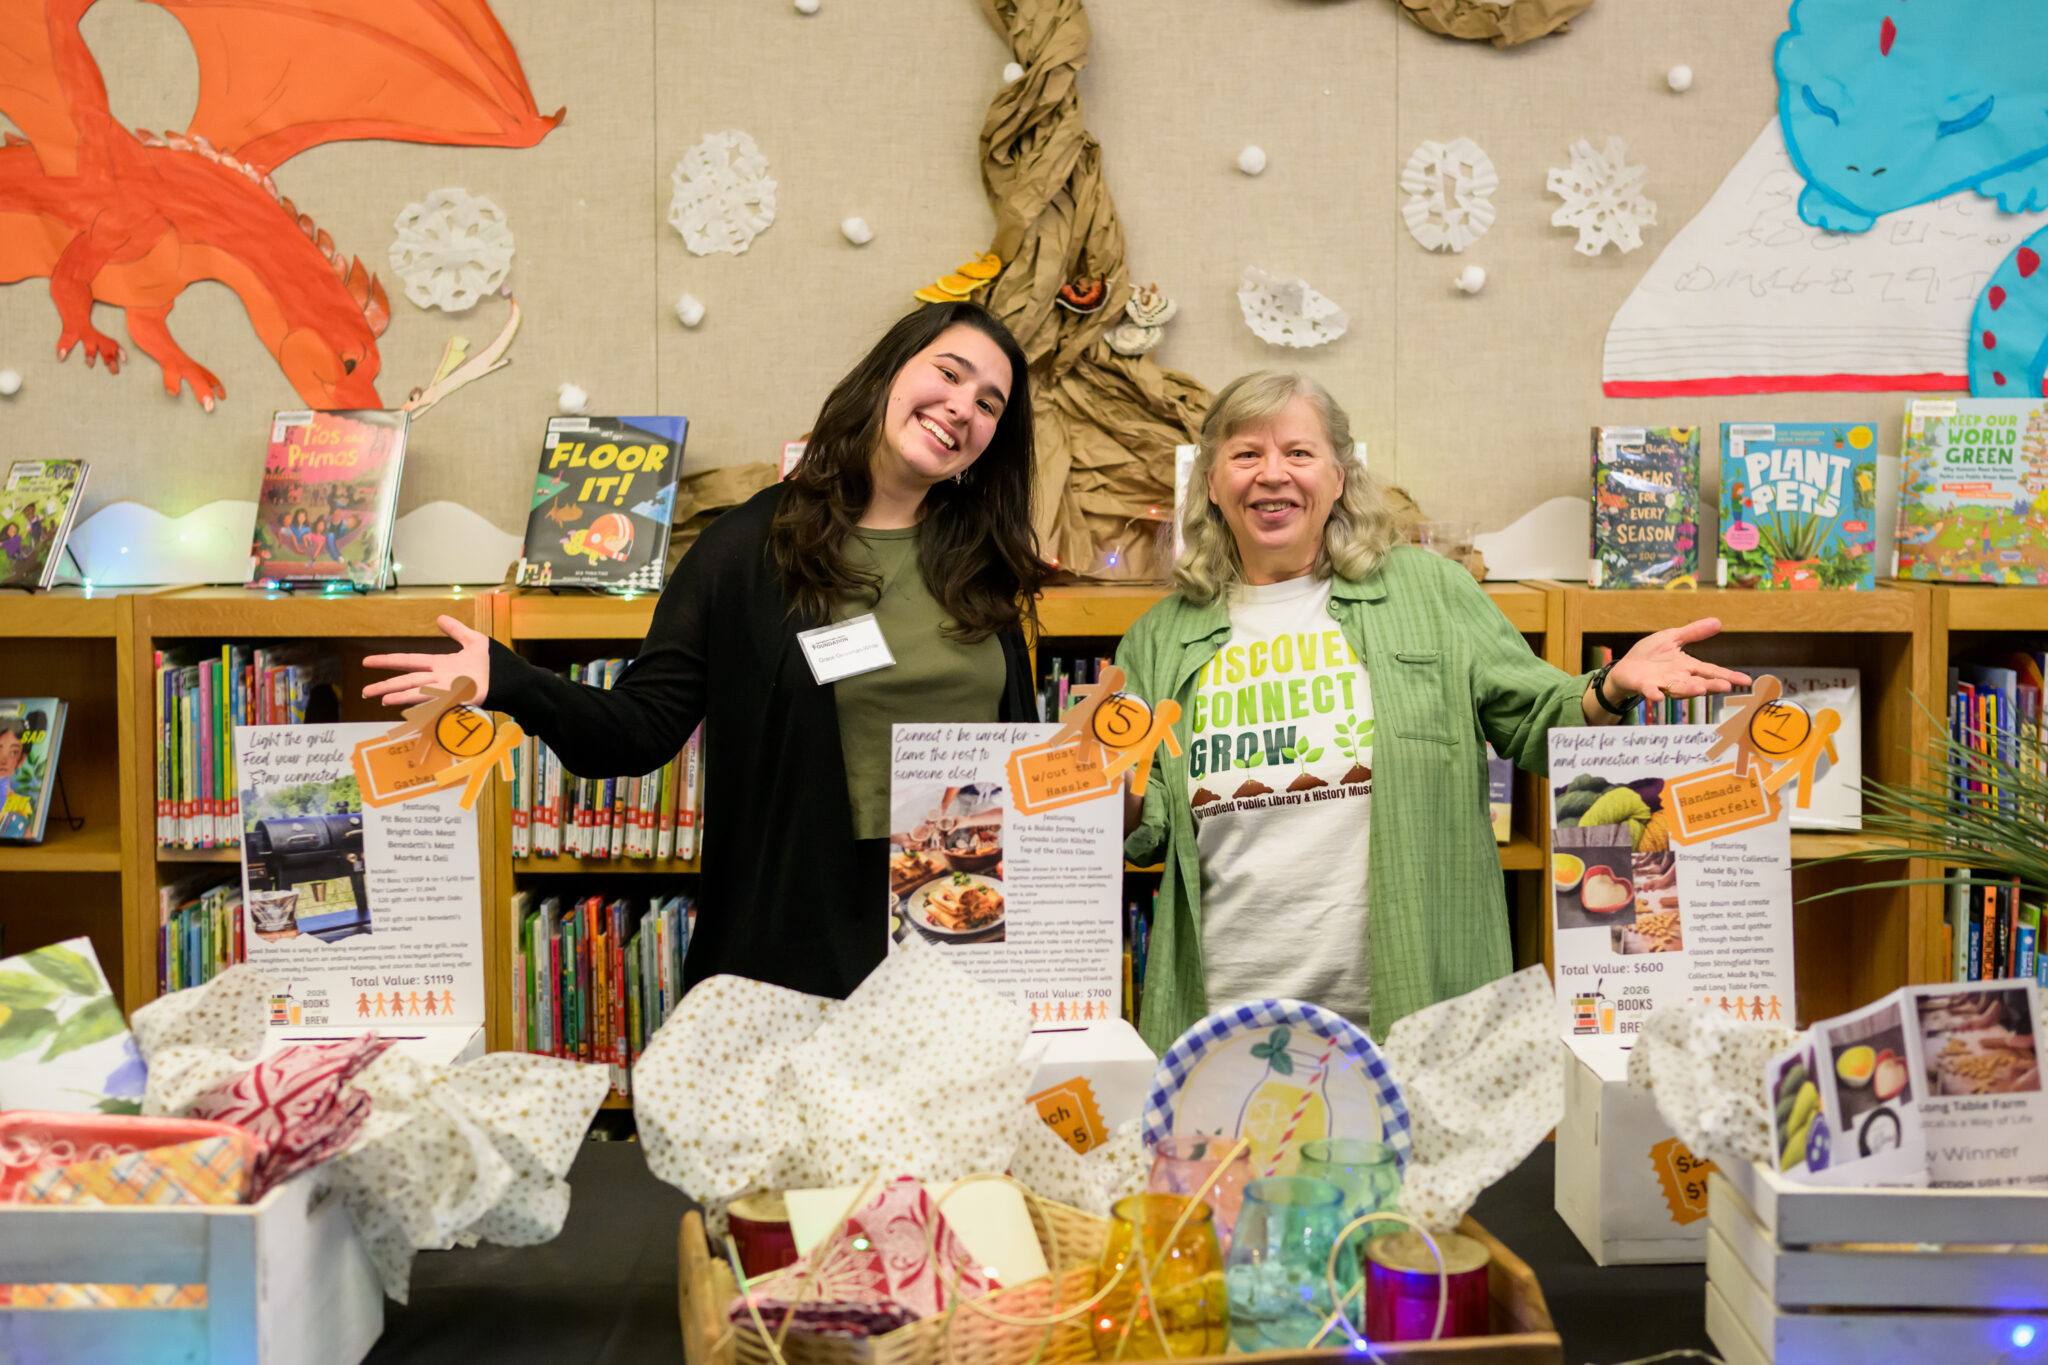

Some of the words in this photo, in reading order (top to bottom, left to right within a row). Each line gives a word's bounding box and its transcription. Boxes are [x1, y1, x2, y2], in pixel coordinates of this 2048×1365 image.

[1949, 414, 1982, 426] KEEP
[1986, 414, 2017, 426] OUR
[1948, 428, 2017, 445] WORLD
[288, 444, 358, 469] Primos
[549, 442, 669, 472] FLOOR
[1946, 448, 2013, 464] GREEN
[1745, 448, 1851, 498] PLANT
[578, 473, 635, 506] IT!
[1639, 492, 1658, 504] FOR
[1751, 480, 1840, 518] PETS
[1630, 508, 1665, 520] EVERY
[1617, 524, 1676, 544] SEASON
[1194, 672, 1356, 734] CONNECT
[1107, 693, 1139, 735] #5
[1763, 700, 1792, 742] #1
[452, 705, 484, 748] #4
[20, 730, 46, 744] SAD
[250, 732, 280, 750] Light
[284, 732, 301, 746] the
[307, 730, 335, 748] grill
[896, 728, 942, 742] Connect
[958, 728, 970, 742] be
[976, 728, 1007, 742] cared
[1011, 728, 1028, 744] for
[1552, 733, 1596, 750] Perfect
[1600, 732, 1616, 750] for
[1622, 731, 1668, 748] sharing
[242, 751, 270, 766] Feed
[275, 754, 300, 766] your
[306, 748, 344, 766] people
[895, 746, 926, 762] Leave
[930, 747, 947, 761] the
[952, 748, 977, 762] rest
[980, 748, 989, 761] to
[1046, 749, 1076, 763] Host
[1190, 726, 1296, 778] GROW
[1554, 754, 1576, 768] and
[1581, 754, 1640, 766] connection
[894, 770, 944, 780] someone
[948, 766, 978, 780] else!
[1032, 768, 1068, 783] w/out
[1076, 761, 1097, 773] the
[248, 769, 280, 792] Stay
[284, 768, 340, 783] connected
[1046, 781, 1090, 797] Hassle
[1679, 784, 1742, 808] Handmade
[1750, 779, 1758, 788] &
[1237, 797, 1266, 810] Public
[1268, 794, 1301, 807] Library
[1304, 793, 1310, 802] &
[1312, 788, 1346, 802] History
[1349, 784, 1372, 796] Muse
[402, 803, 440, 812] featuring
[1688, 798, 1758, 824] Heartfelt
[1043, 814, 1076, 823] featuring
[387, 828, 411, 837] Bright
[1056, 825, 1085, 834] formerly
[1087, 826, 1094, 834] of
[1020, 846, 1032, 854] Top
[1711, 842, 1747, 851] featuring
[394, 854, 422, 862] Market
[433, 854, 448, 862] Deli
[1679, 854, 1719, 863] Stringfield
[1741, 855, 1779, 863] Collective
[1727, 867, 1737, 876] By
[1696, 880, 1715, 888] Long
[1748, 923, 1772, 931] gather
[1699, 936, 1727, 944] through
[1732, 947, 1774, 955] experiences
[1560, 965, 1589, 976] Total
[1592, 964, 1630, 974] Value:
[1634, 962, 1664, 974] $600
[1694, 960, 1711, 968] from
[1713, 960, 1751, 968] Stringfield
[350, 976, 379, 987] Total
[382, 975, 420, 986] Value:
[424, 974, 454, 985] $1119
[1024, 989, 1048, 999] Total
[1052, 989, 1084, 999] Value:
[1087, 988, 1112, 998] $700
[1622, 986, 1650, 995] 2026
[1709, 984, 1726, 992] Long
[303, 999, 330, 1008] BOOKS
[1618, 998, 1653, 1011] BOOKS
[305, 1016, 329, 1025] BREW
[1620, 1022, 1643, 1034] BRE
[1953, 1101, 1989, 1111] Table
[1993, 1100, 2027, 1110] Farm
[1073, 1128, 1087, 1144] 5
[1942, 1146, 2019, 1162] Winner
